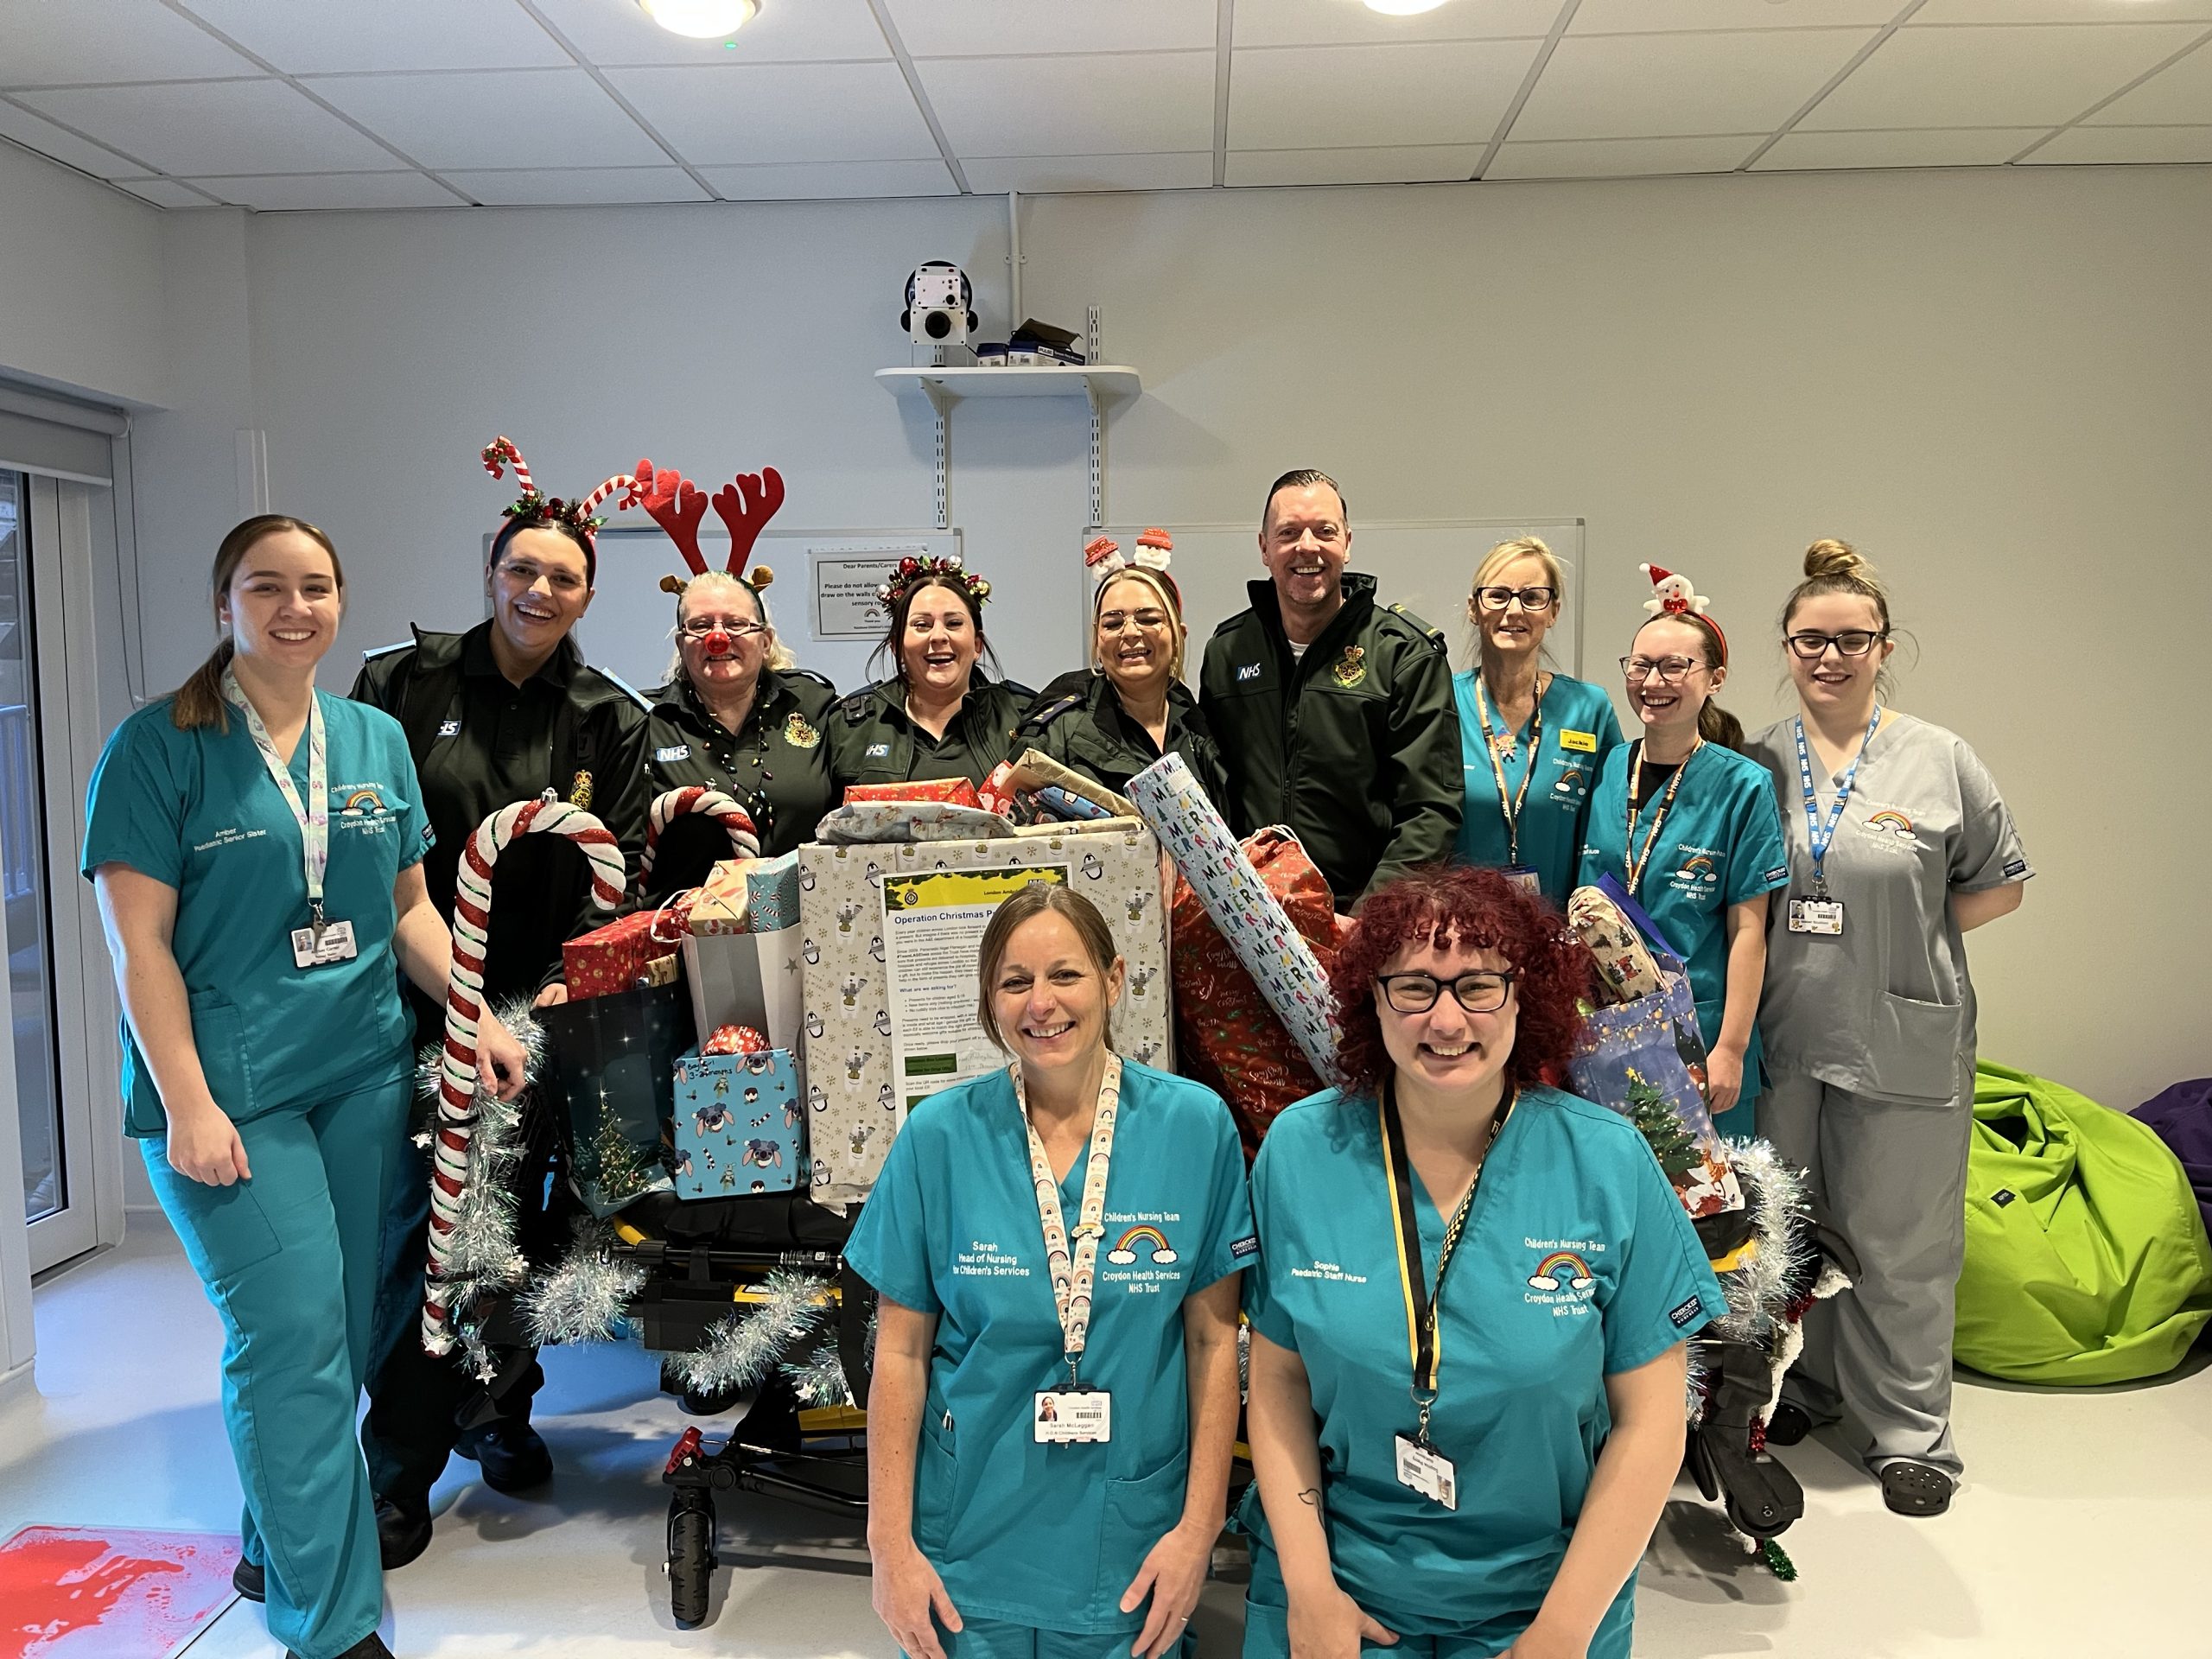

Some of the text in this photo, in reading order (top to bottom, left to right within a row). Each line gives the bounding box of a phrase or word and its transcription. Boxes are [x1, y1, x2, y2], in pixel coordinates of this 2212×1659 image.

[1239, 663, 1260, 679] NHS
[660, 745, 689, 761] NHS
[1827, 812, 1839, 828] NHS
[215, 828, 237, 838] Amber
[223, 833, 245, 844] Senior
[247, 829, 266, 838] Sister
[1821, 831, 1831, 847] NHS
[1670, 881, 1690, 890] Croydon
[894, 912, 938, 925] Operation
[939, 911, 983, 920] Christmas
[1104, 1211, 1180, 1223] Children's Nursing Team
[972, 1241, 998, 1252] Sarah
[1524, 1237, 1558, 1249] Children's
[1560, 1238, 1586, 1251] Nursing
[958, 1253, 1017, 1266] Head of Nursing
[960, 1265, 992, 1275] Children's
[994, 1265, 1030, 1276] Services
[1313, 1261, 1339, 1272] Sophie
[1103, 1269, 1180, 1282] Croydon Health Services
[1291, 1268, 1367, 1283] Paediatric Staff Nurse
[1128, 1282, 1160, 1293] NHS Trust
[1524, 1293, 1554, 1305] Croydon
[1555, 1292, 1578, 1303] Health
[1553, 1304, 1589, 1317] NHS Trust
